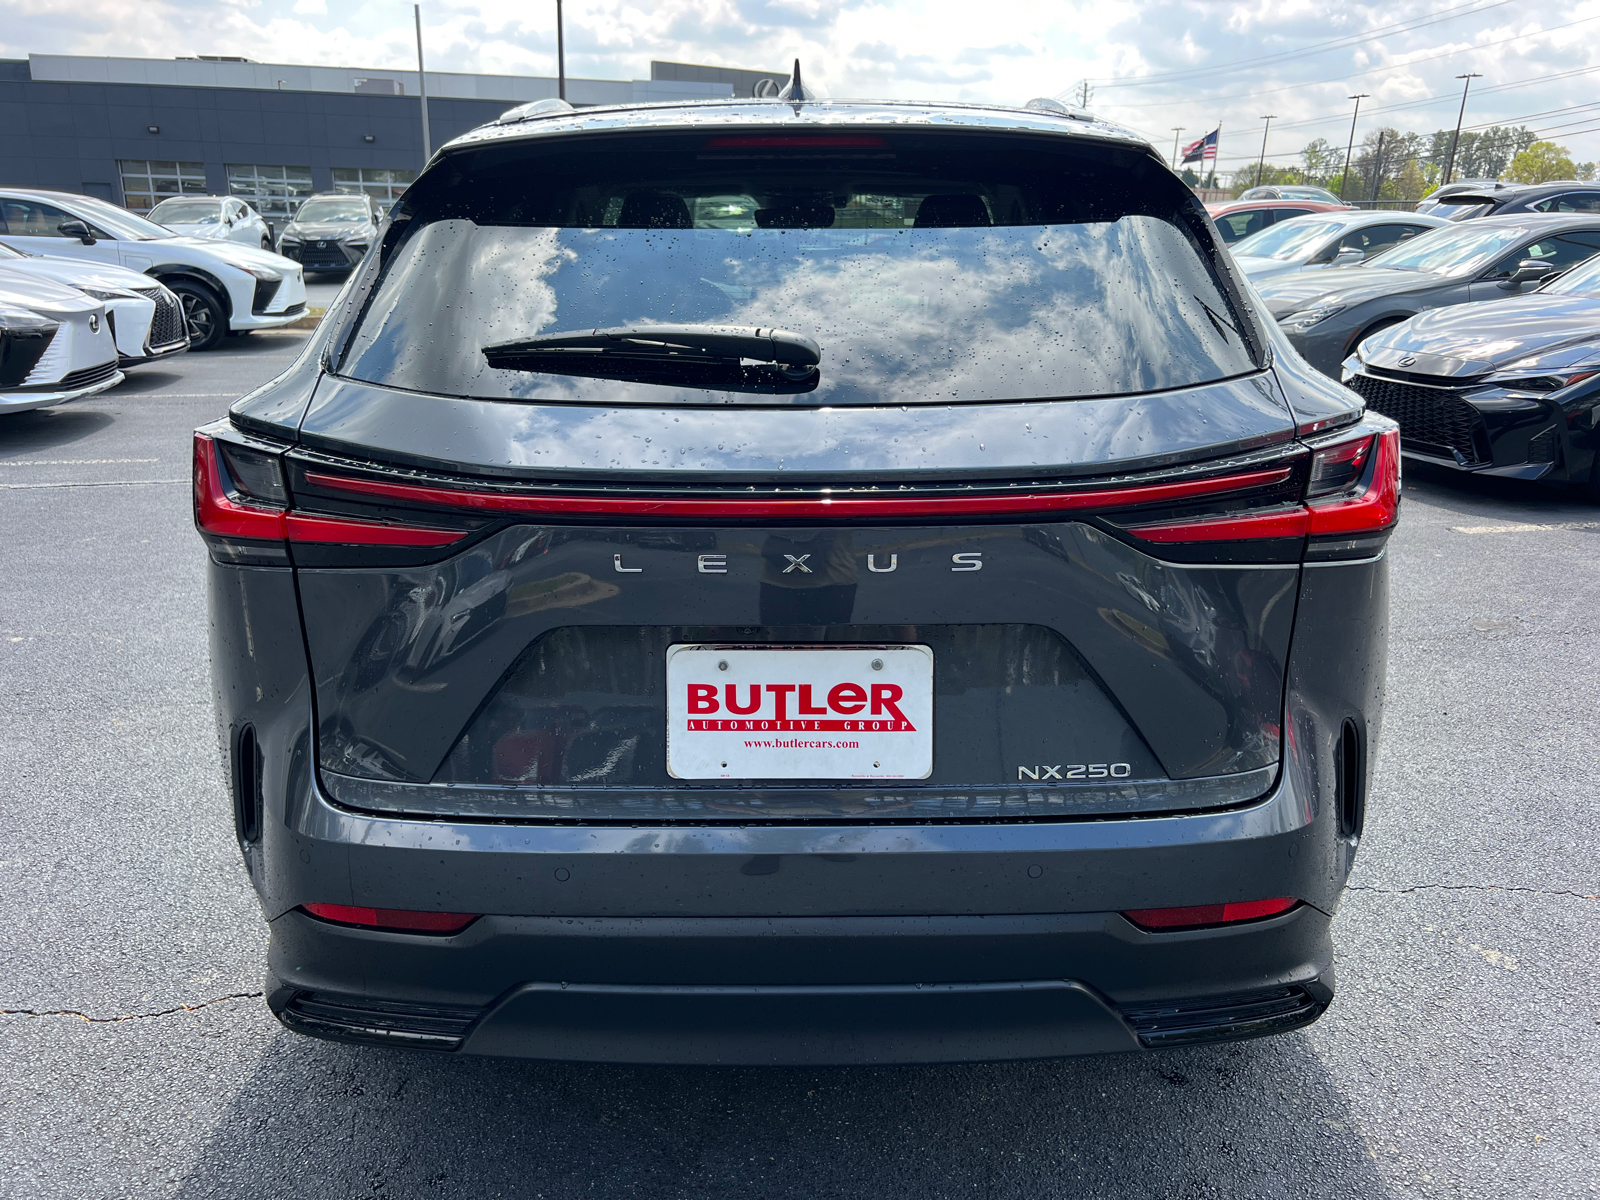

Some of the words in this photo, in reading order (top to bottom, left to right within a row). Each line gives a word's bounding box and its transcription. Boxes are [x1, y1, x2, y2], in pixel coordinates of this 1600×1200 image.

[613, 552, 983, 574] LEXUS
[688, 720, 821, 731] AUTOMOTIVE
[844, 720, 908, 731] GROUP
[743, 738, 859, 749] www.butlercars.com
[1017, 762, 1131, 780] NX250
